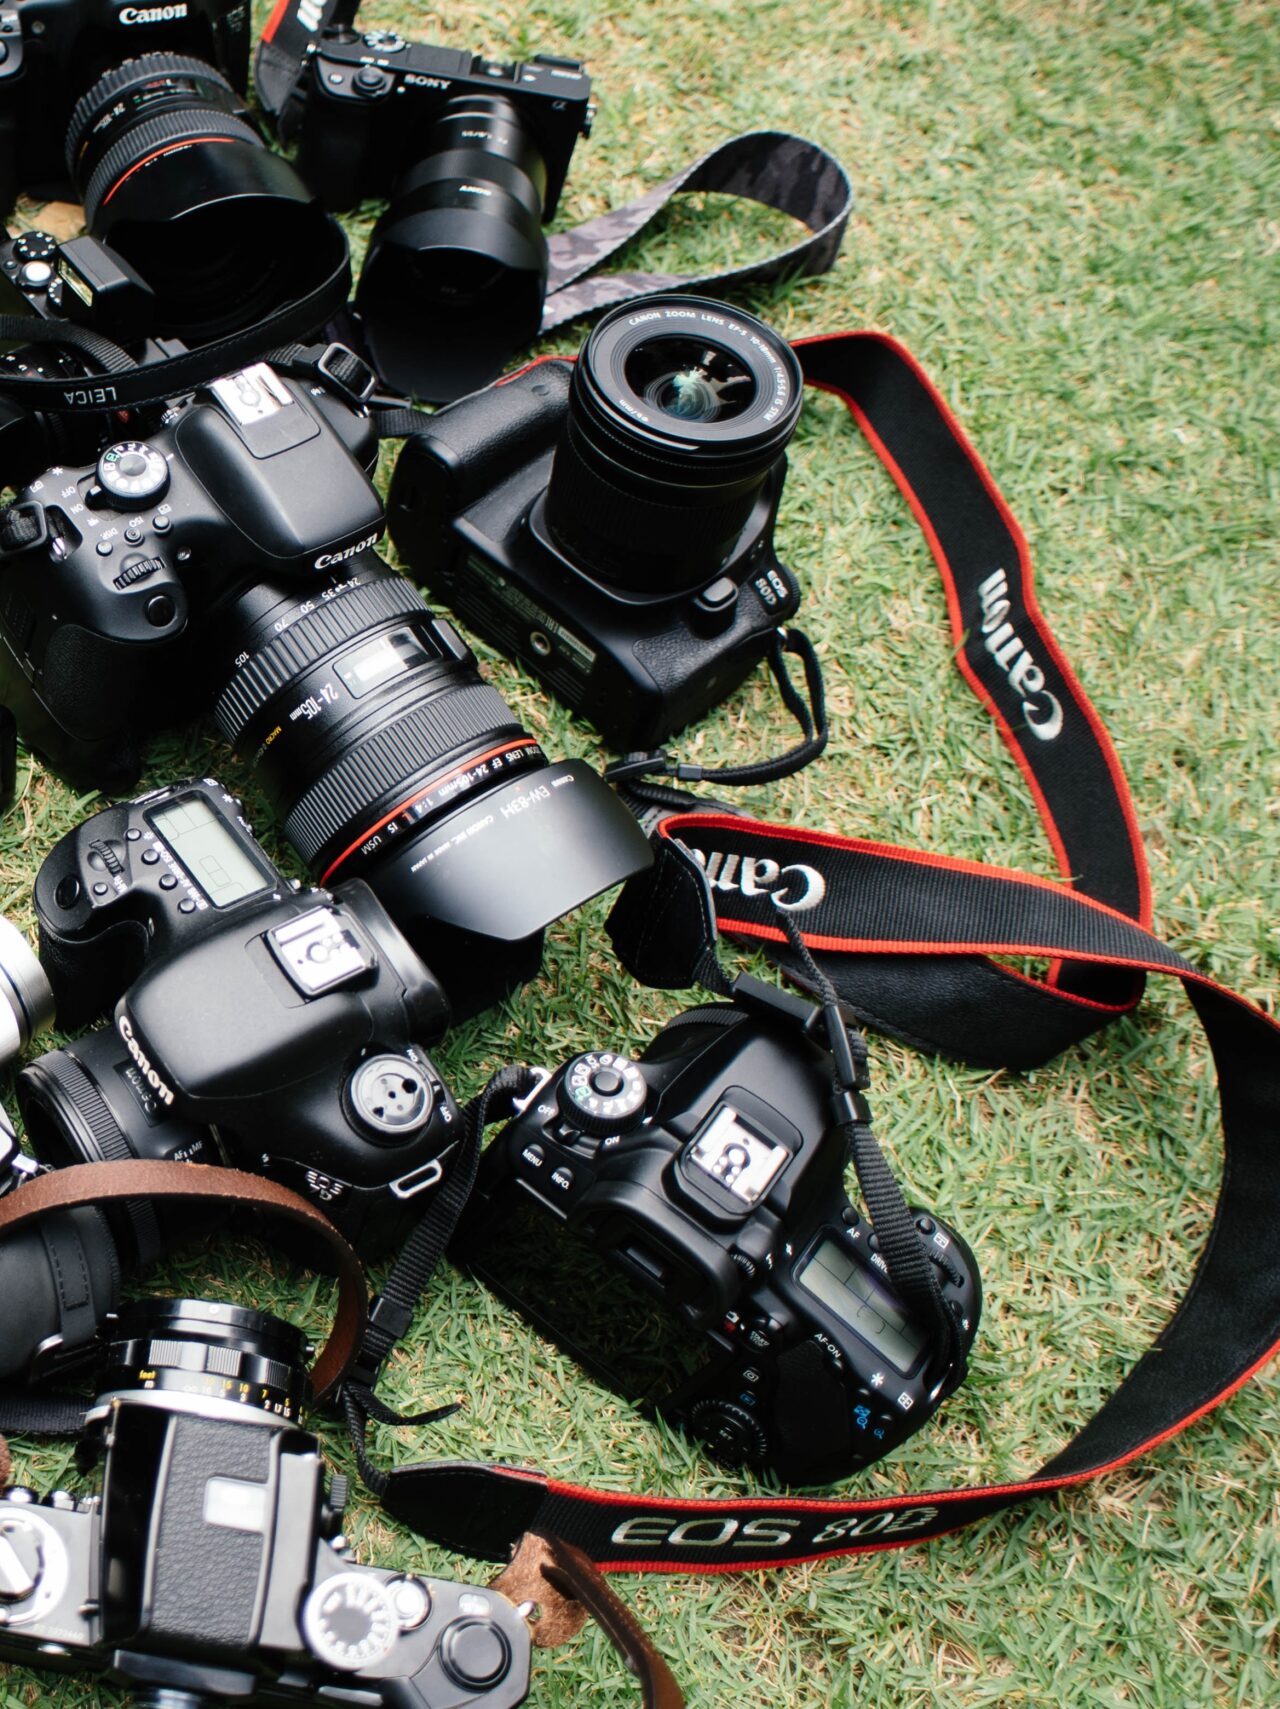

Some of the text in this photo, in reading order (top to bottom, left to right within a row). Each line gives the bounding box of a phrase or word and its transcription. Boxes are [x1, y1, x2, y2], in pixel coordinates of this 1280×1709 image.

[119, 3, 188, 25] Canon
[404, 74, 452, 90] SONY
[628, 311, 661, 326] CANON
[665, 311, 696, 319] ZOOM
[701, 314, 725, 326] LENS
[63, 386, 117, 405] LEICA
[61, 485, 76, 500] OFF
[70, 503, 84, 515] ON
[128, 516, 144, 528] ISO
[314, 532, 378, 569] Canon
[767, 569, 788, 598] EOS
[234, 576, 361, 668] 24 35 50 70 105
[978, 568, 1063, 740] Canon
[289, 683, 339, 721] 24-105mm
[492, 757, 503, 769] EF
[506, 748, 524, 763] LENS
[499, 785, 552, 821] EW-83H
[387, 821, 399, 834] IS
[361, 835, 382, 856] USM
[674, 838, 826, 912] Can
[119, 1016, 174, 1105] Canon
[407, 1048, 418, 1062] ON
[439, 1105, 452, 1123] OFF
[537, 1104, 555, 1116] OFF
[605, 1135, 620, 1146] ON
[522, 1148, 543, 1167] MENU
[846, 1226, 860, 1240] AF
[814, 1332, 842, 1359] AF-ON
[239, 1383, 250, 1393] 10
[261, 1389, 268, 1399] 7
[264, 1399, 271, 1410] 2
[611, 1507, 939, 1547] EOS 80D
